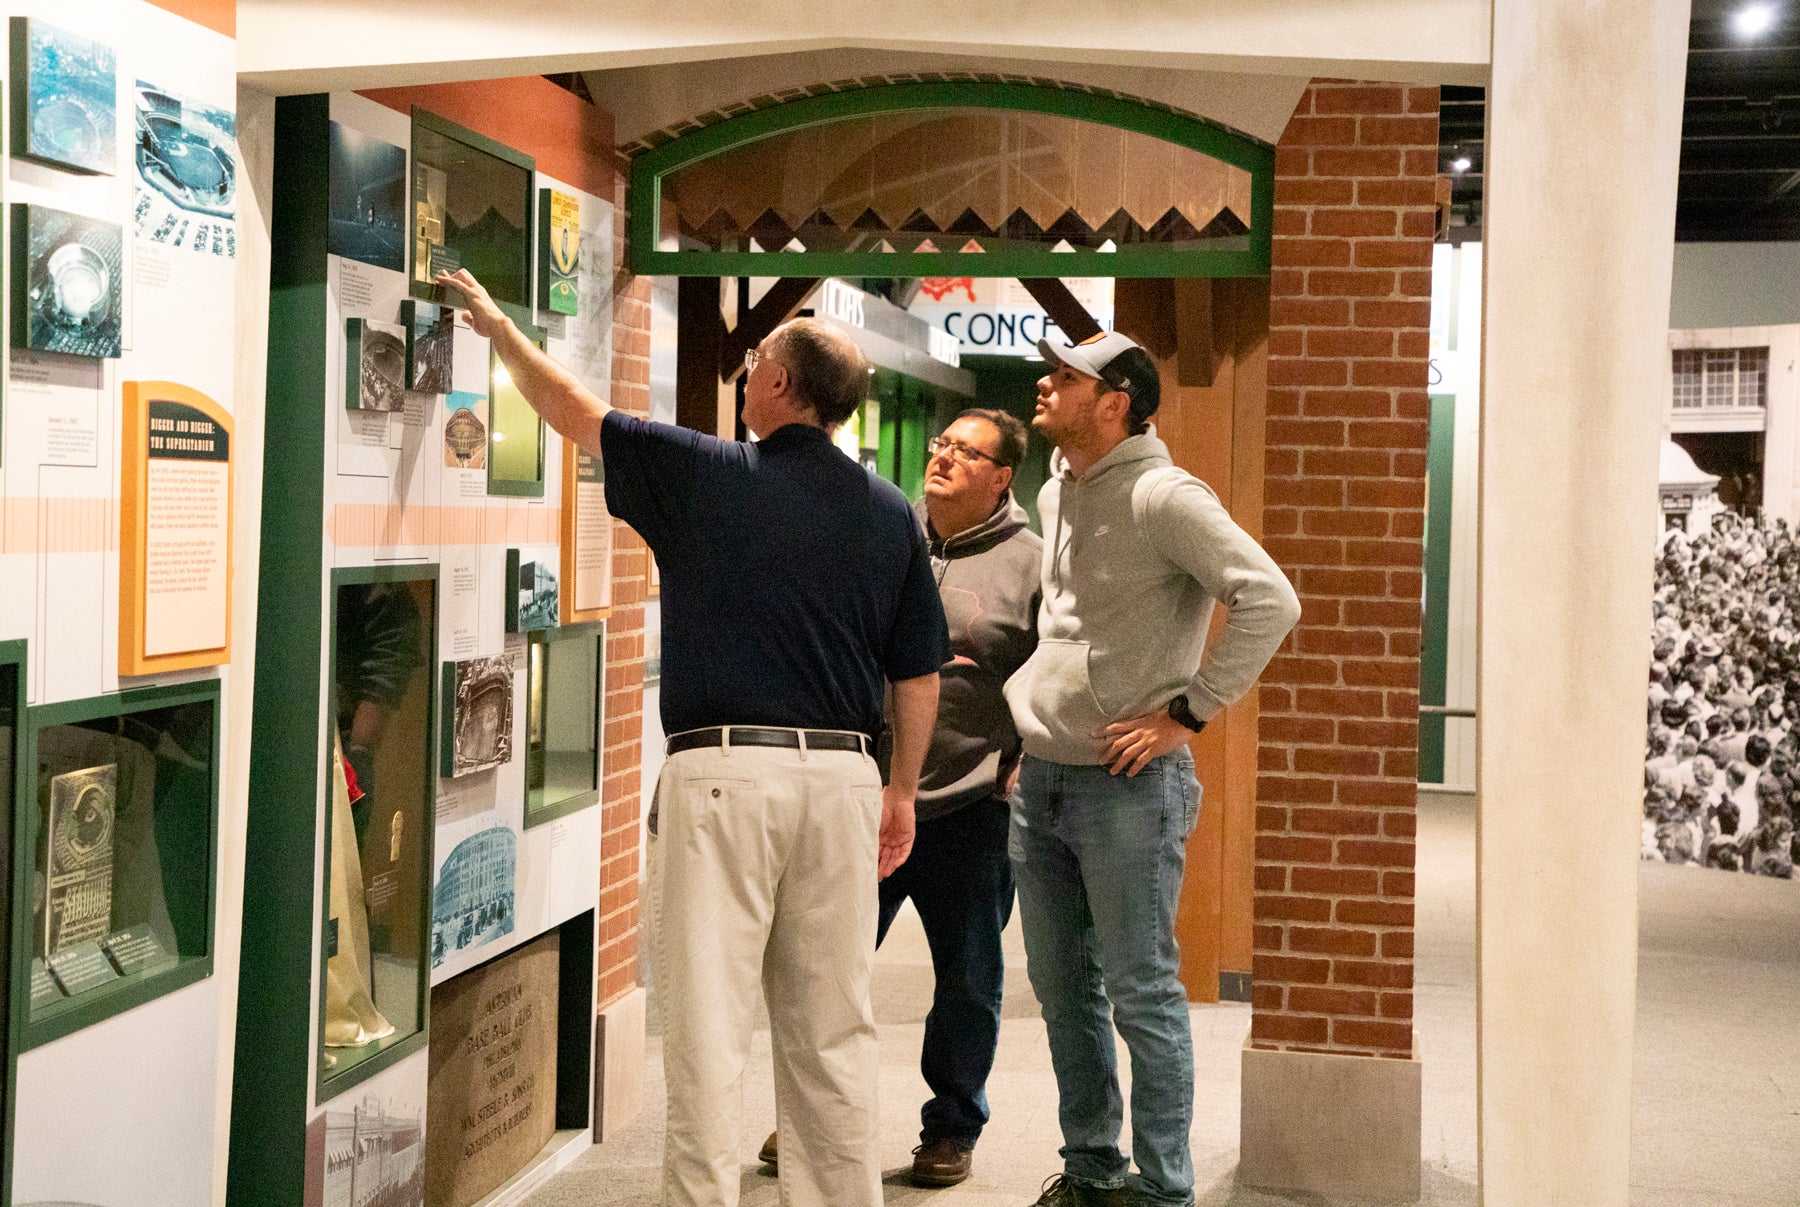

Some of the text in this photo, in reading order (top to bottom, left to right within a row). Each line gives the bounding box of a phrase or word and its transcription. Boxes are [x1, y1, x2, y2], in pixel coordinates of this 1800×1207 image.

[151, 418, 174, 431] BIGGER
[176, 420, 189, 432] AND
[151, 436, 214, 451] THE SUPERSTADIUM
[467, 1028, 489, 1055] BASE
[493, 1016, 512, 1037] BALL
